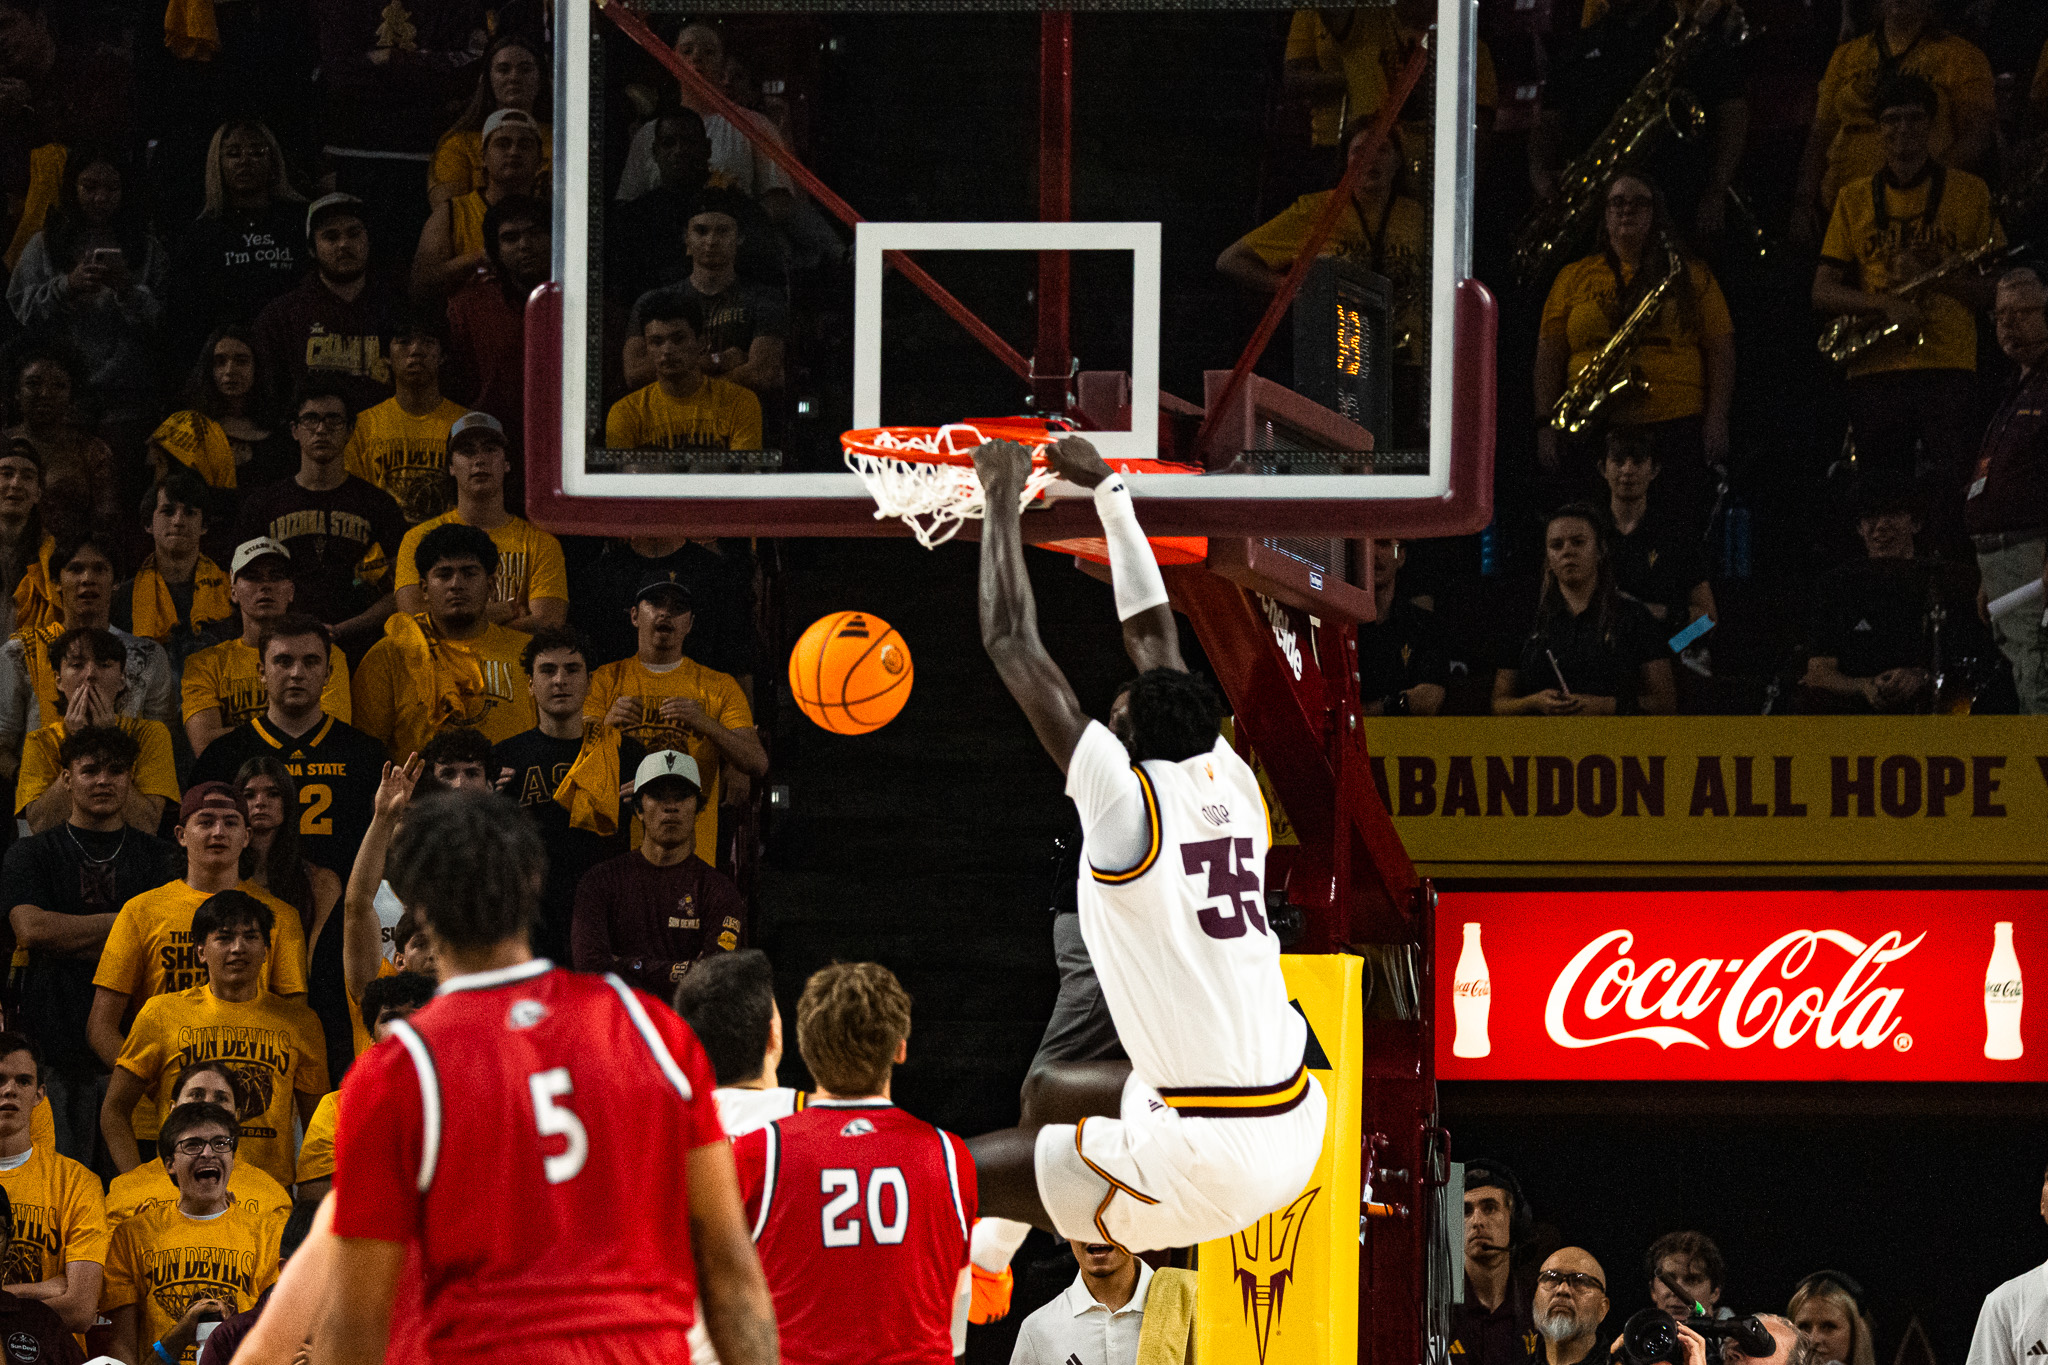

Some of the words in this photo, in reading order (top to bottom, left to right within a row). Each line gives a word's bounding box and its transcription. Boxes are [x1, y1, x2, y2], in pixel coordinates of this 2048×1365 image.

[225, 250, 250, 266] I'm
[255, 247, 294, 261] cold.
[242, 233, 275, 247] Yes,
[330, 511, 371, 546] STATE
[307, 763, 347, 776] STATE
[1690, 755, 1808, 817] ALL
[1830, 755, 2007, 817] HOPE
[1180, 836, 1268, 940] 35
[1544, 928, 1928, 1050] Coca-Cola
[178, 1026, 219, 1070] SUN
[221, 1026, 291, 1077] DEVILS
[528, 1066, 589, 1185] 5
[821, 1166, 909, 1248] 20
[142, 1247, 182, 1298] SUN
[184, 1246, 255, 1298] DEVILS
